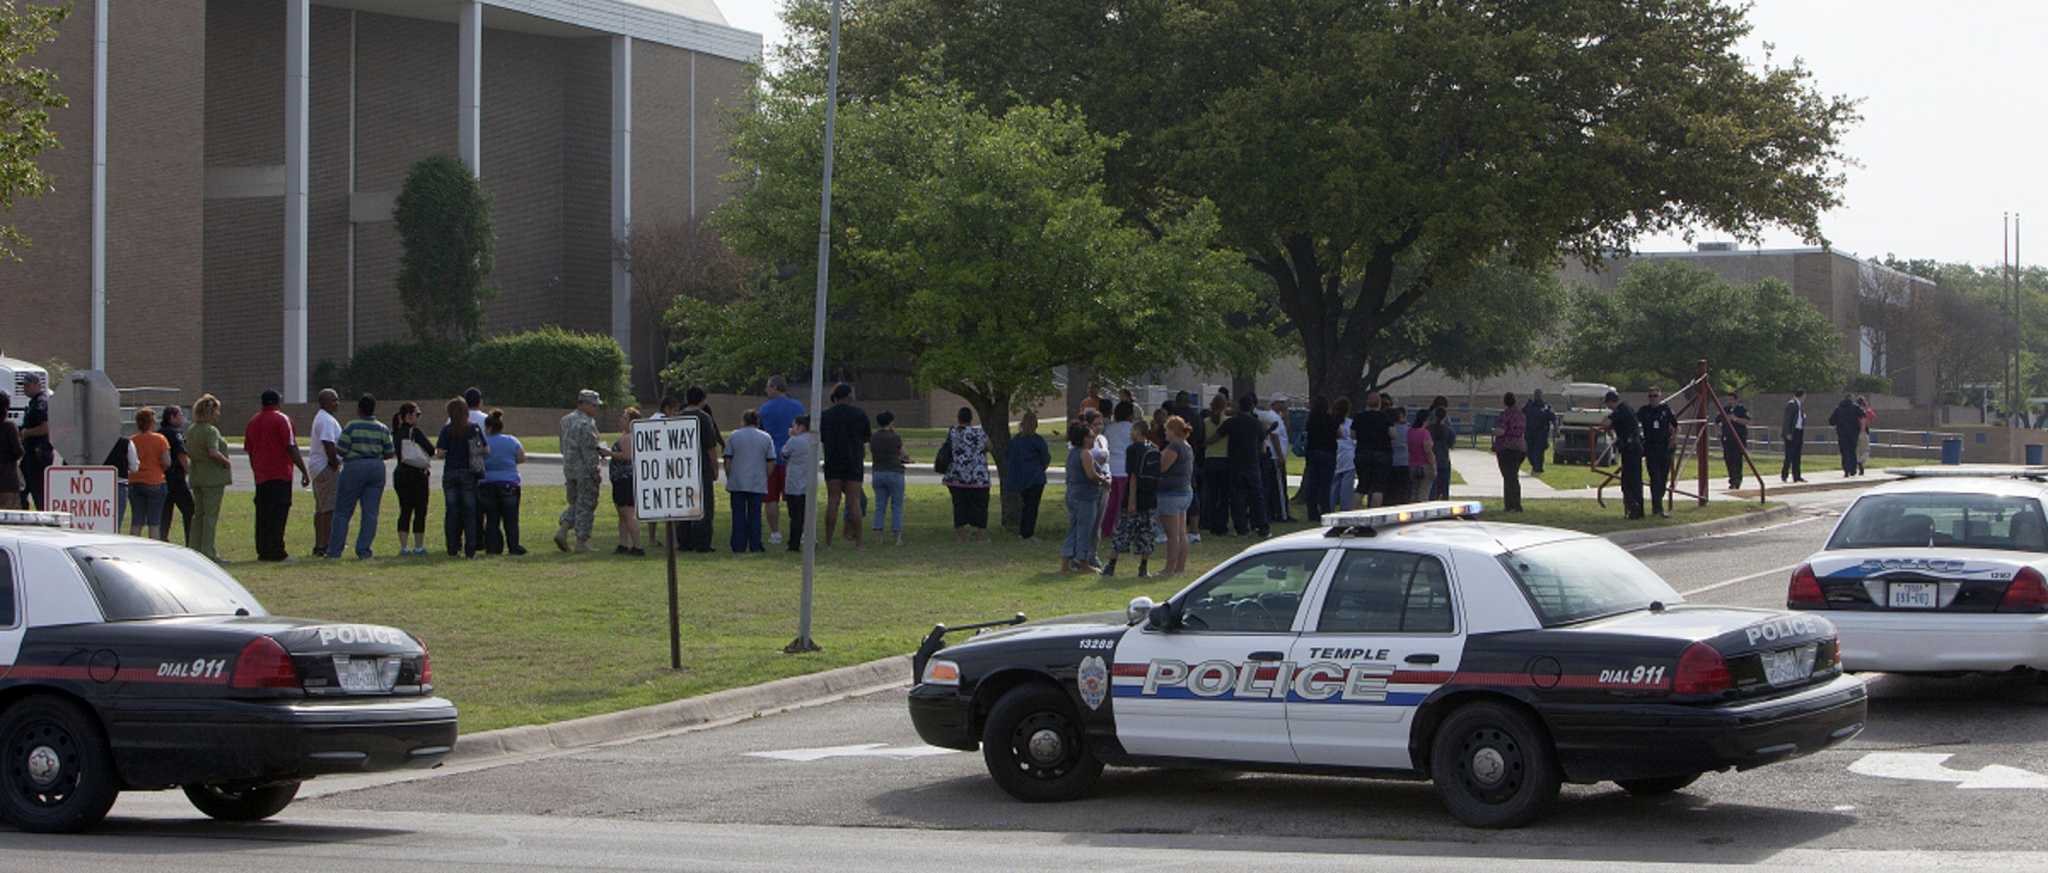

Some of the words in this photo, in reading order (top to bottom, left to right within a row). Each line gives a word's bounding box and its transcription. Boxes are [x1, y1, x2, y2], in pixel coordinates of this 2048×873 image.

[636, 429, 662, 452] ONE
[667, 428, 695, 450] WAY
[641, 459, 660, 481] DO
[666, 457, 692, 480] NOT
[70, 476, 93, 494] NO
[52, 499, 111, 517] PARKING
[643, 486, 695, 510] ENTER
[319, 626, 403, 646] POLICE
[1745, 618, 1817, 646] POLICE
[1310, 647, 1390, 660] TEMPLE
[157, 662, 188, 677] DIAL
[190, 658, 226, 678] 911
[1599, 669, 1630, 683] DIAL
[1631, 665, 1666, 684] 911
[1142, 658, 1396, 701] POLICE
